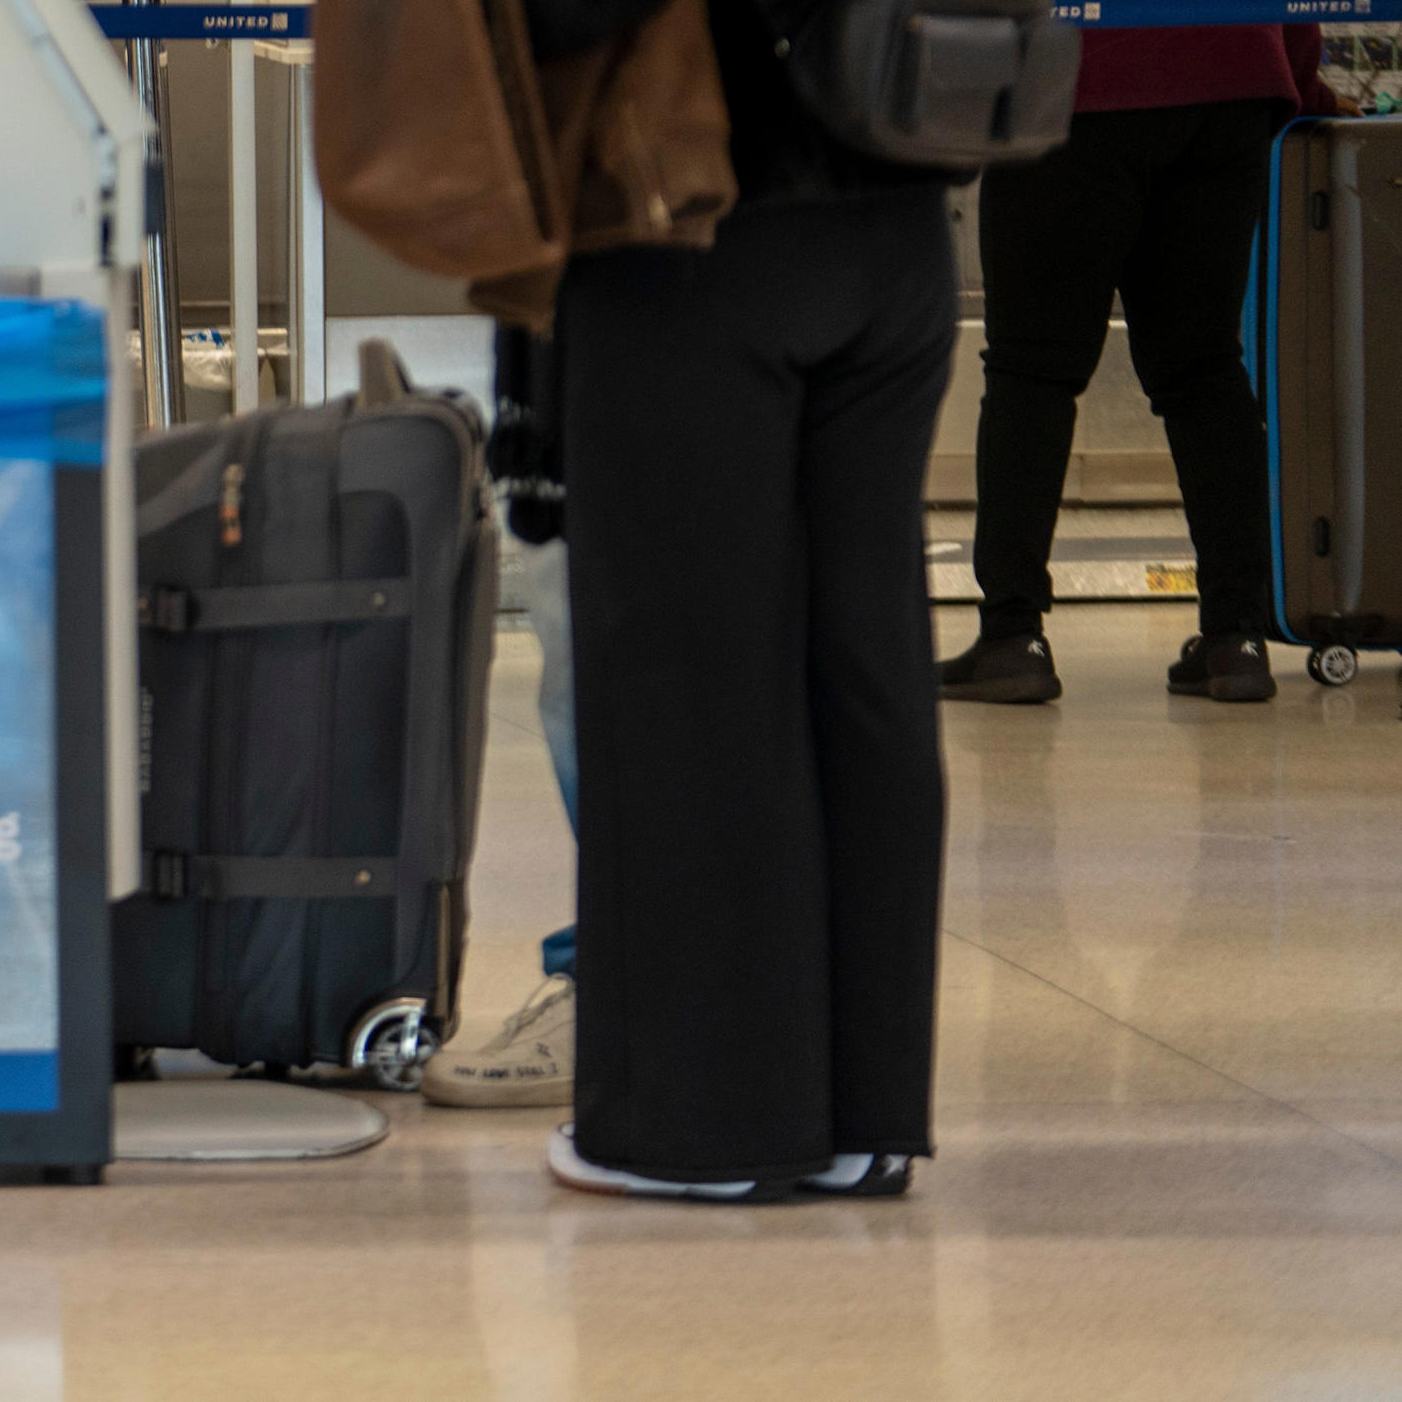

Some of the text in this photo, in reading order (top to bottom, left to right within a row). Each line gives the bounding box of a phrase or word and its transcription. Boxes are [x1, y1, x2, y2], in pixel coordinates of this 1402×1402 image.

[1049, 5, 1081, 18] TED
[1287, 0, 1352, 14] UNITED
[203, 15, 269, 29] UNITED
